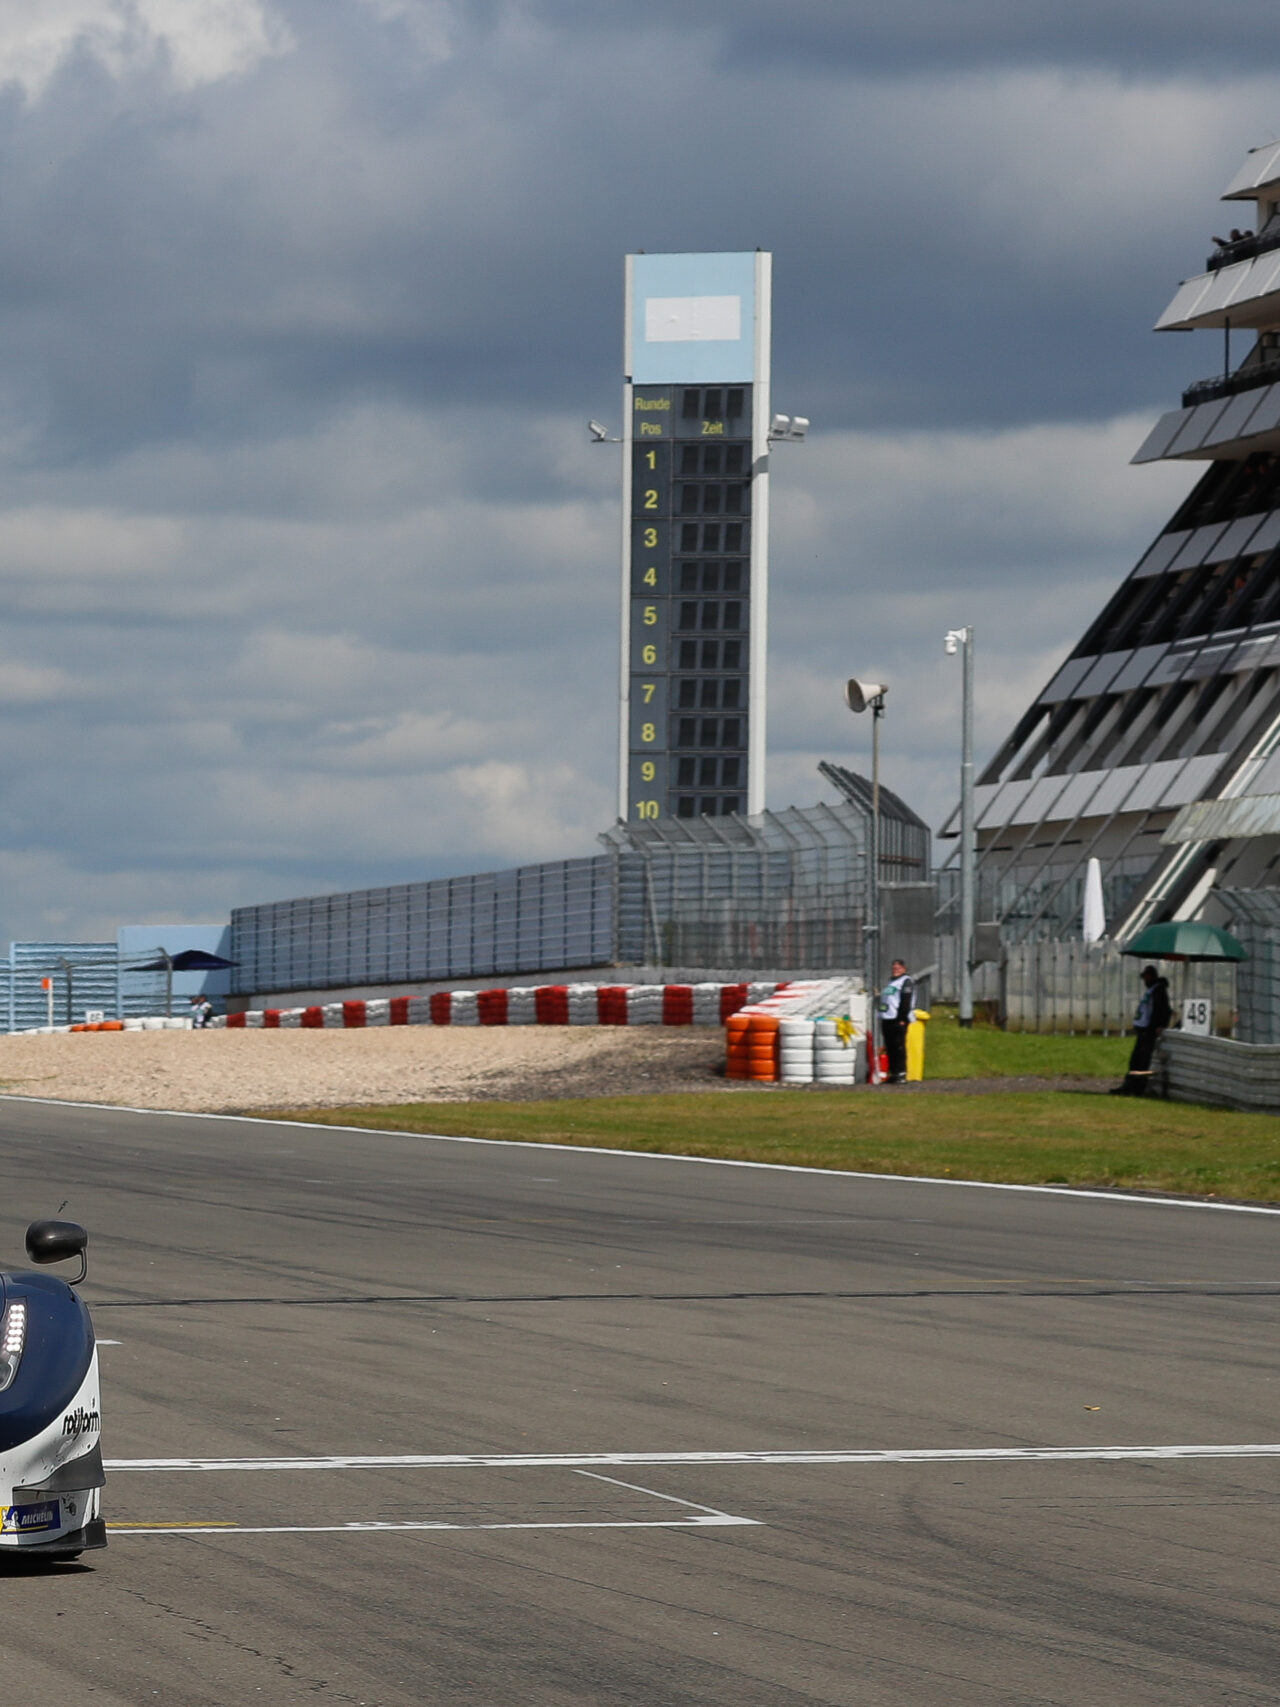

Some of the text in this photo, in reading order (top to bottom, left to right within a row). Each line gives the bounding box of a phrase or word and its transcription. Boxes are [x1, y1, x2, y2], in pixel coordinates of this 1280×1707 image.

[635, 397, 670, 410] Runde
[641, 421, 723, 435] Pos Zeit
[647, 451, 656, 470] 1
[645, 490, 657, 509] 2
[644, 528, 657, 547] 3
[643, 568, 656, 586] 4
[643, 607, 656, 625] 5
[643, 645, 656, 664] 6
[642, 685, 655, 703] 7
[642, 723, 655, 742] 8
[641, 762, 654, 781] 9
[636, 801, 658, 820] 10
[1187, 1003, 1206, 1025] 48
[62, 1406, 99, 1441] rotiform
[21, 1511, 53, 1526] MICHELIN
